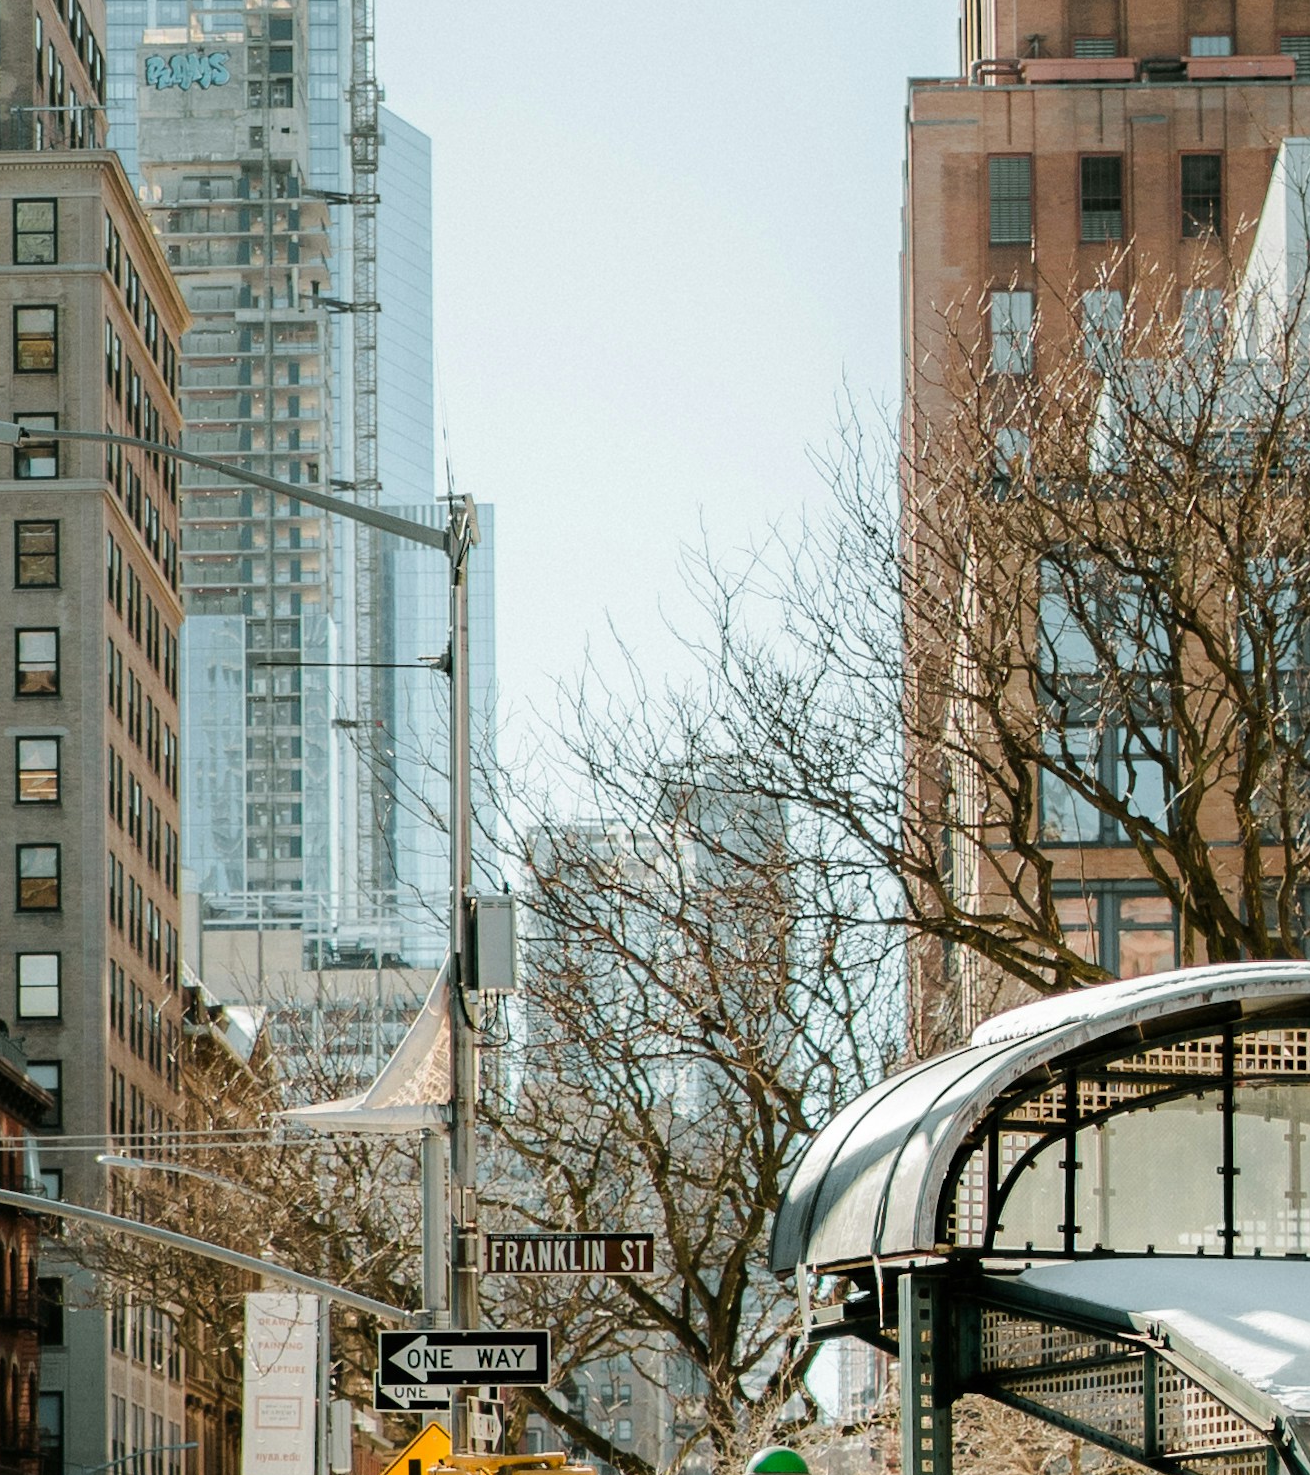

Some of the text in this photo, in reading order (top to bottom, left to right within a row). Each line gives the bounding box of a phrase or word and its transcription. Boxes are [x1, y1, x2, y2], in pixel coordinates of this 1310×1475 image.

[491, 1240, 647, 1271] FRANKLIN ST
[407, 1348, 526, 1369] ONE WAY
[394, 1388, 428, 1399] ONE
